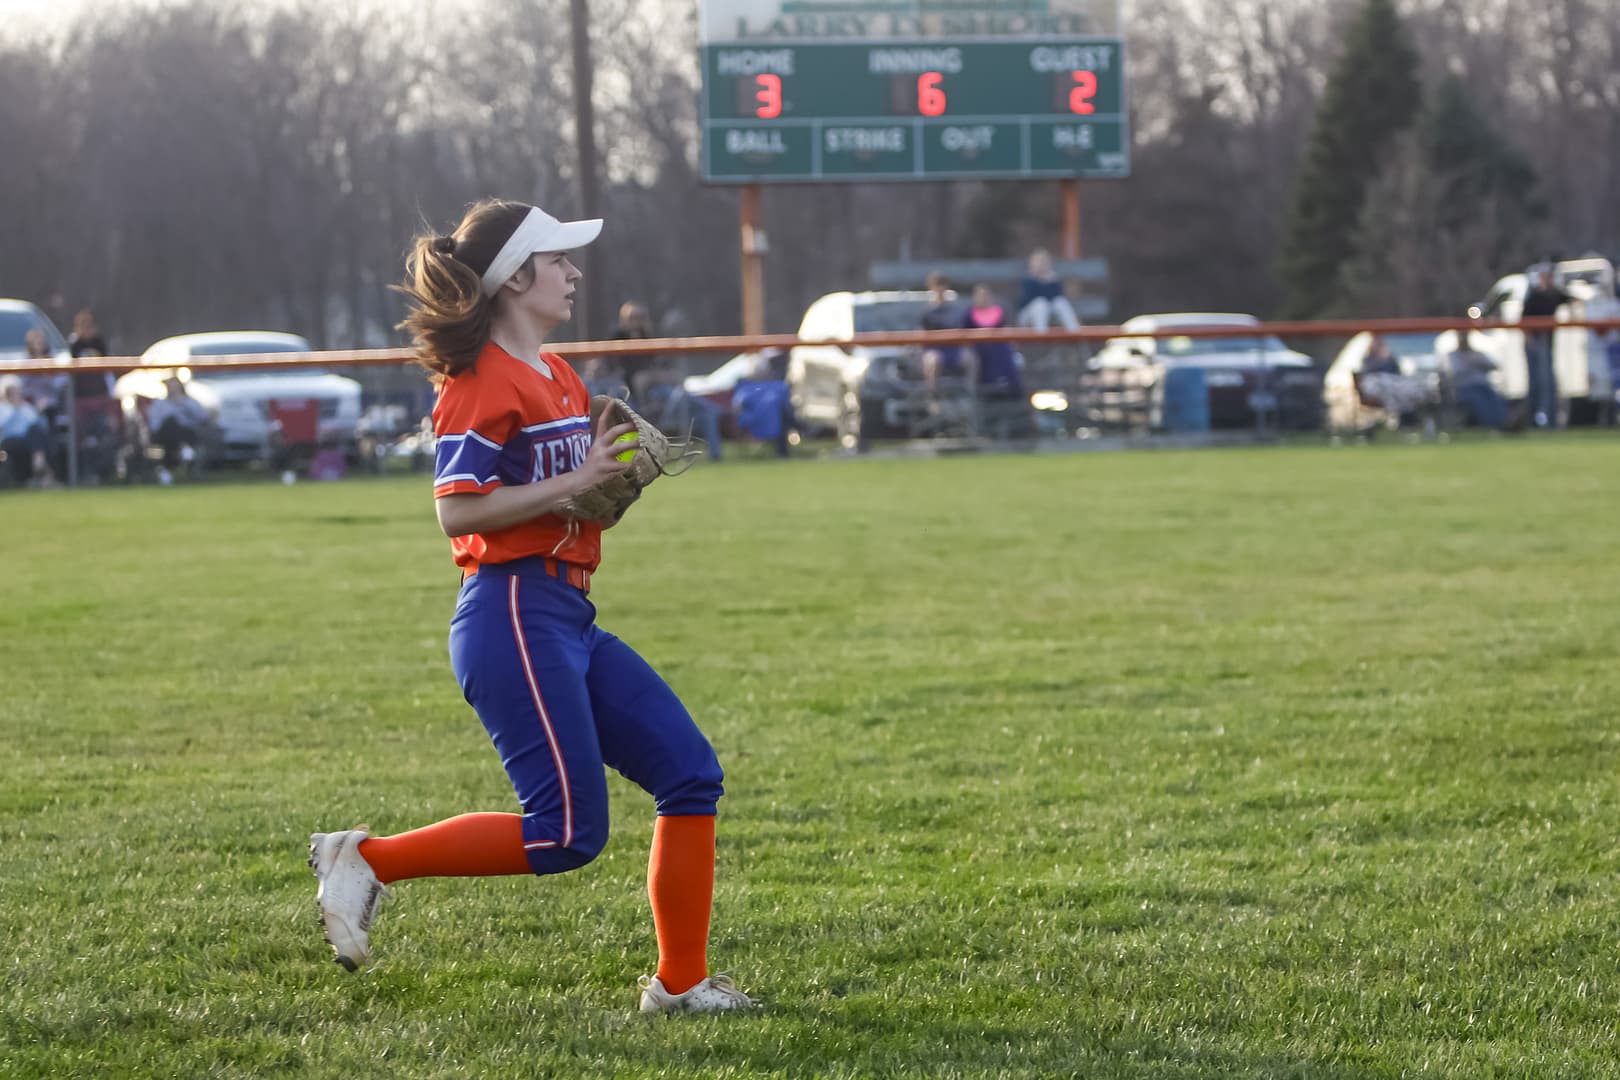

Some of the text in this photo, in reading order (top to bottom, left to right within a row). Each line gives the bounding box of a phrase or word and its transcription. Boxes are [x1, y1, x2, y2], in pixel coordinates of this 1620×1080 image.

[718, 50, 795, 75] HOME
[868, 48, 963, 73] INNING
[1029, 46, 1111, 72] GUEST
[755, 74, 782, 118] 3
[917, 72, 946, 116] 6
[1069, 71, 1097, 115] 2
[726, 129, 787, 153] BALL
[825, 127, 905, 152] STRIKE
[941, 126, 995, 150] OUT
